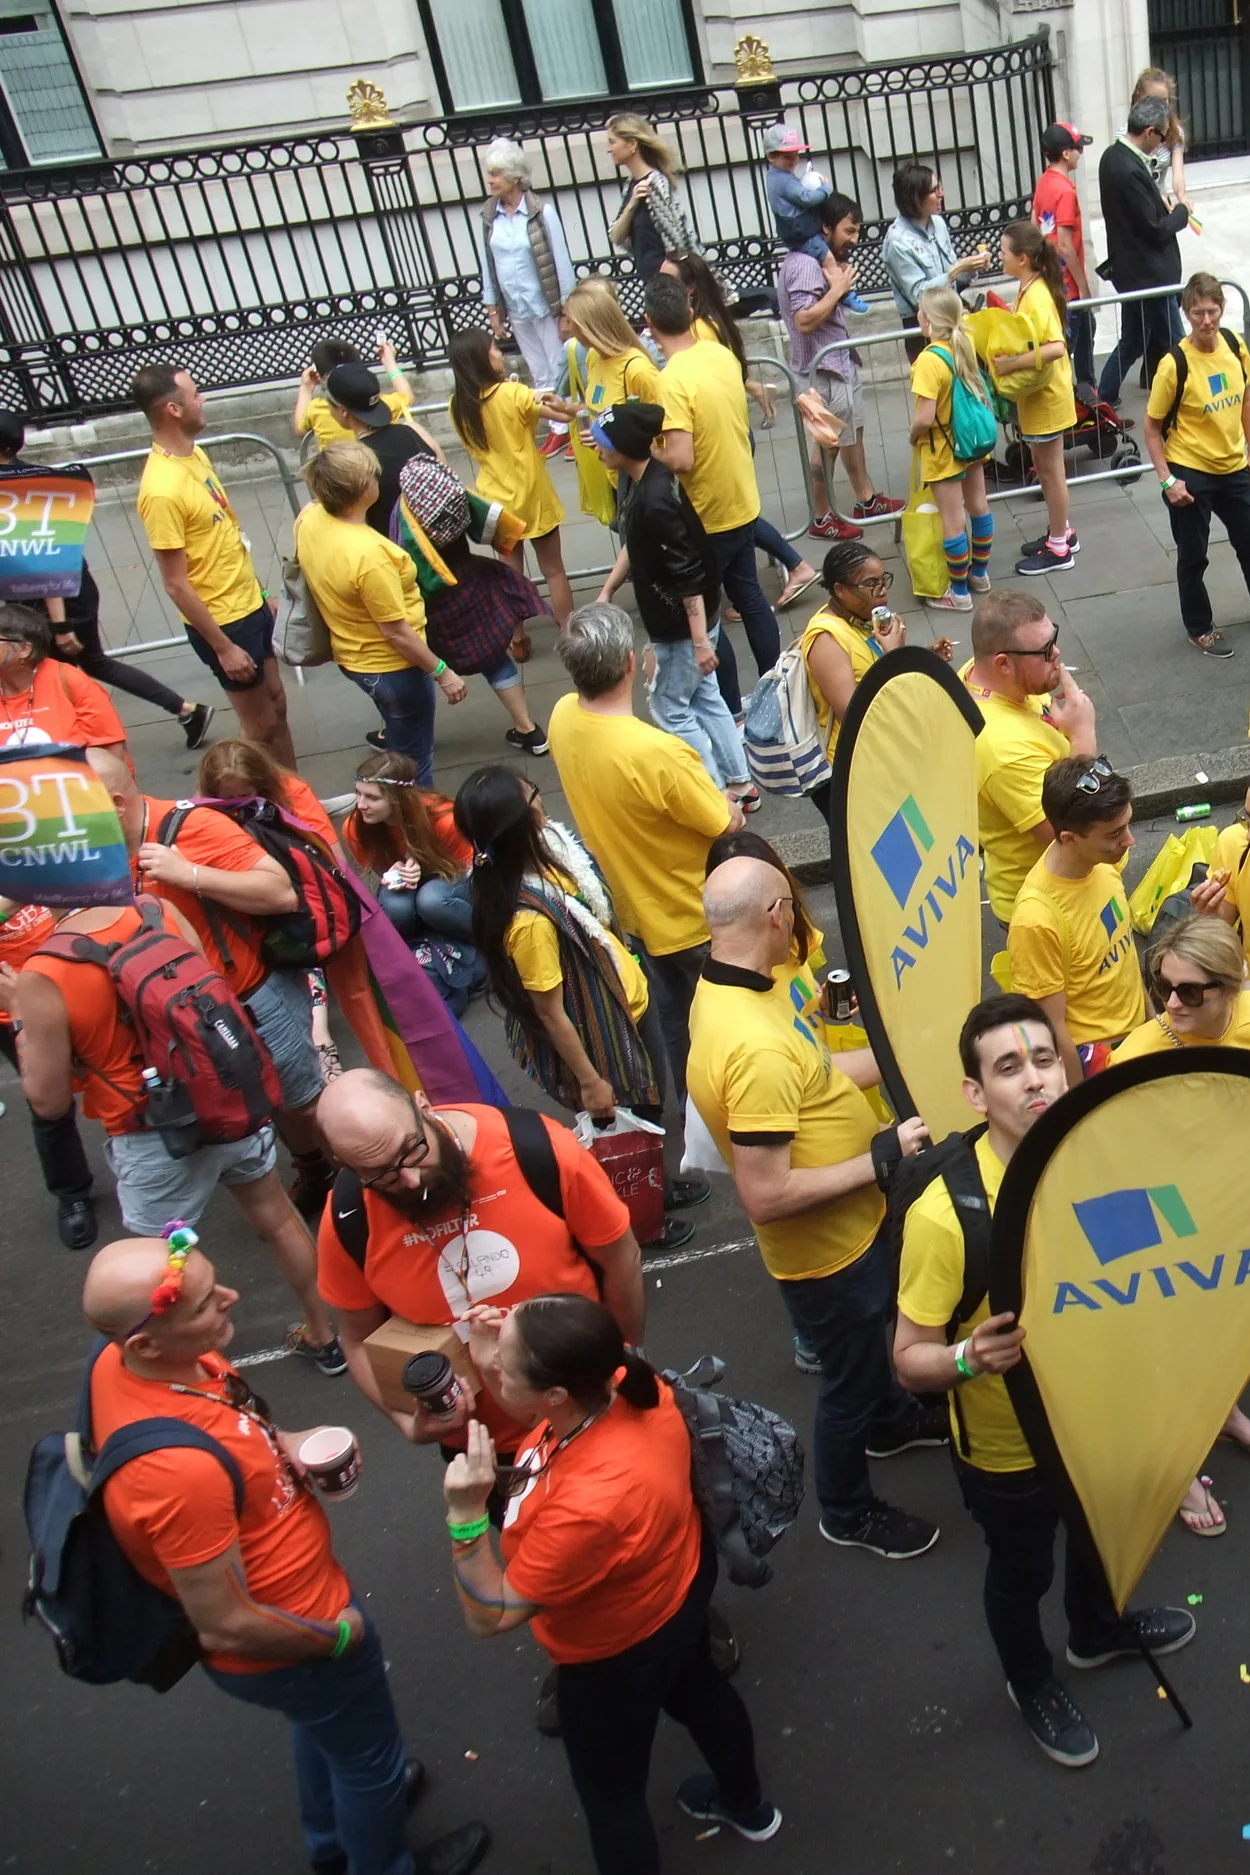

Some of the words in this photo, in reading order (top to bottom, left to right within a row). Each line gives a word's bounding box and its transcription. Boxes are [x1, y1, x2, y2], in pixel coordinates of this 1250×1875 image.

[1203, 394, 1241, 415] AVIVA
[0, 838, 100, 868] CNWL
[890, 834, 976, 992] AVIVA
[402, 1213, 479, 1248] #NOFILTR
